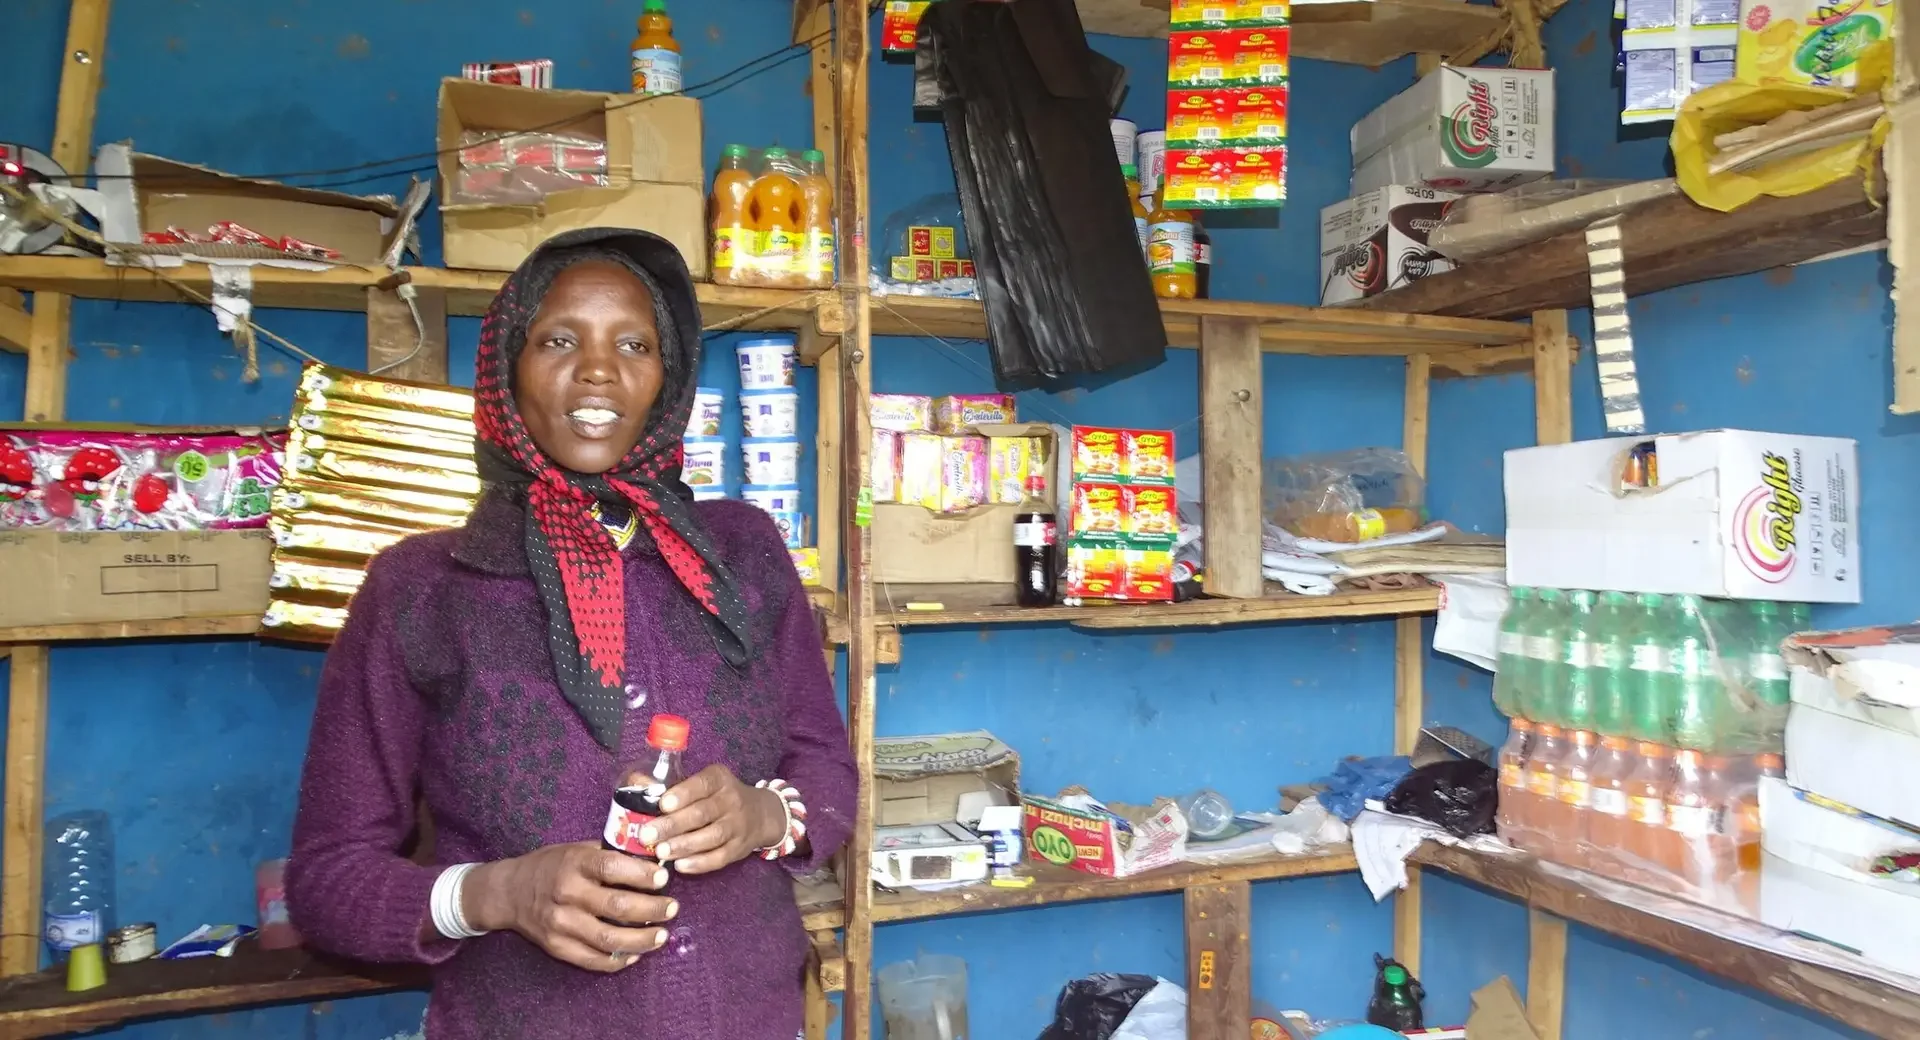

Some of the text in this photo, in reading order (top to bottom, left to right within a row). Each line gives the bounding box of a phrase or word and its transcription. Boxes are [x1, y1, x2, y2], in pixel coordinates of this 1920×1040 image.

[1467, 78, 1499, 142] Right
[1405, 186, 1434, 200] 60 Pcs
[382, 382, 420, 398] GOLD
[962, 408, 1004, 423] Cinderella
[1761, 449, 1802, 550] Right
[123, 553, 191, 564] SELL BY:
[1039, 807, 1104, 834] mchuzi
[1036, 829, 1072, 860] OYO
